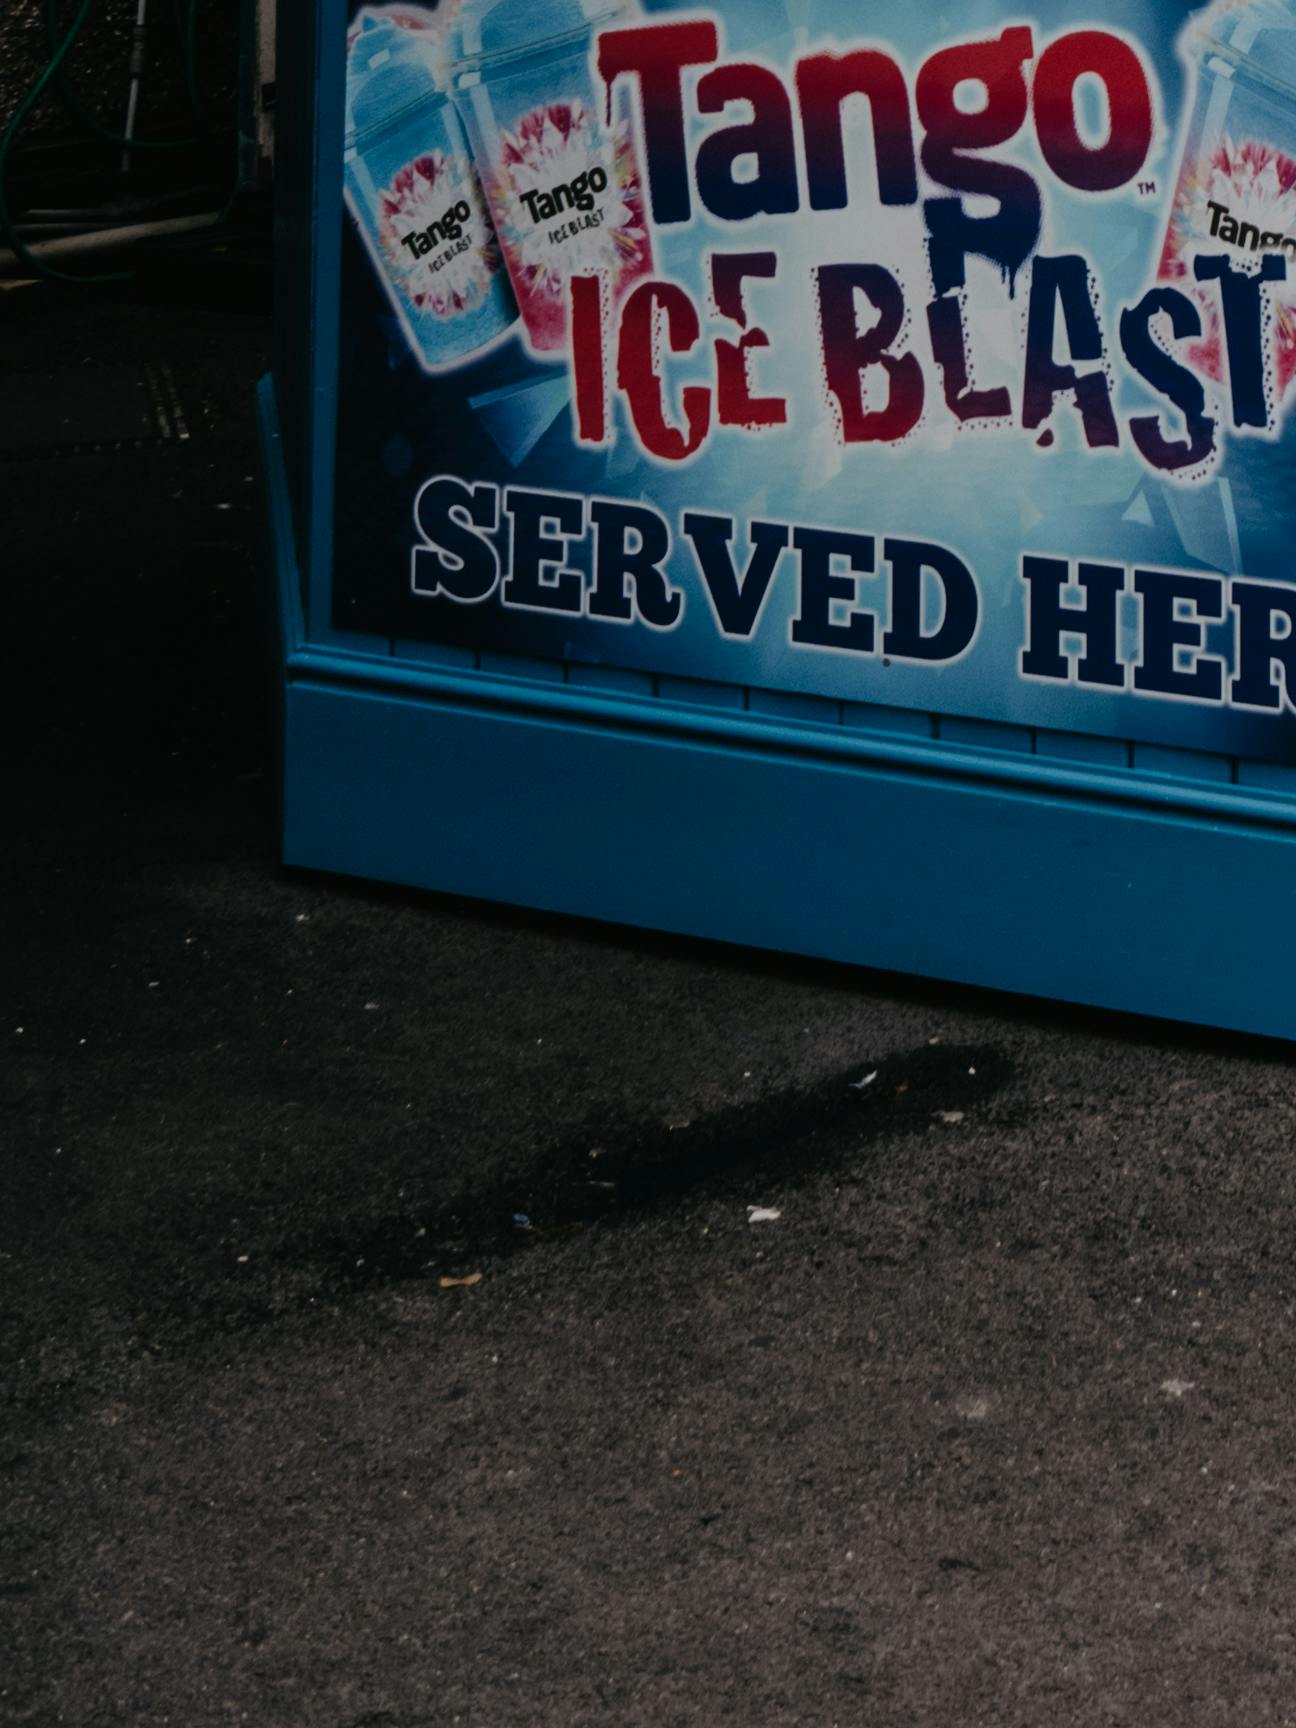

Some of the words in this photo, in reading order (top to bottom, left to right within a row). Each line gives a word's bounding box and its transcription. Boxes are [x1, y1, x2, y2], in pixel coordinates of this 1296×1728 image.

[519, 167, 607, 224] Tango
[598, 17, 1154, 272] Tango
[402, 200, 470, 259] Tango
[549, 226, 568, 244] ICE
[570, 208, 605, 236] BLAST
[569, 251, 787, 461] ICE
[411, 474, 979, 666] SERVED
